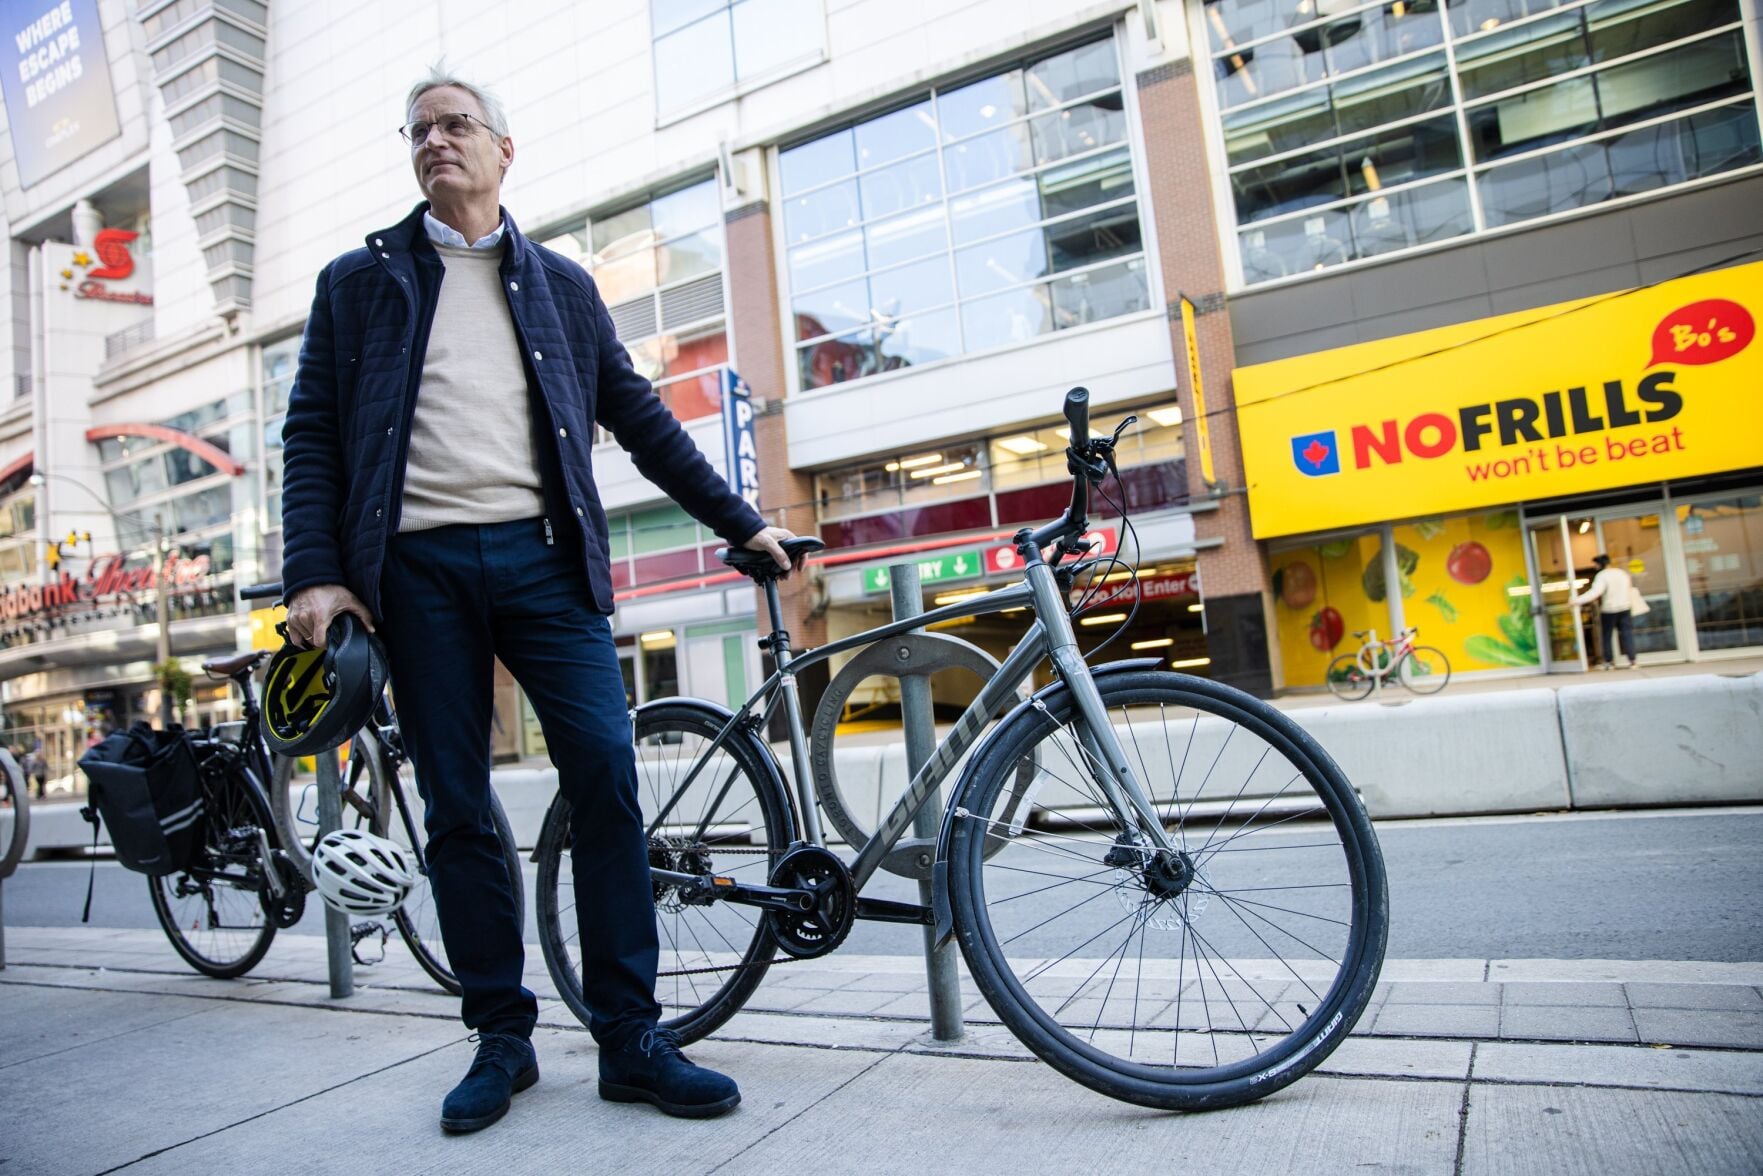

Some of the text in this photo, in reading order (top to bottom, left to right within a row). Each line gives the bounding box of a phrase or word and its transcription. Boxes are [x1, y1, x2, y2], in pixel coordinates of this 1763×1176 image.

[15, 0, 73, 54] WHERE
[18, 25, 80, 83] ESCAPE
[25, 54, 83, 108] BEGINS
[1668, 317, 1737, 352] Bo's
[736, 400, 759, 515] PARK
[1466, 426, 1685, 481] won't be beat
[918, 560, 943, 581] TRY
[1143, 579, 1185, 597] Enter
[879, 695, 989, 846] GIANT
[1316, 1011, 1343, 1046] GIANT
